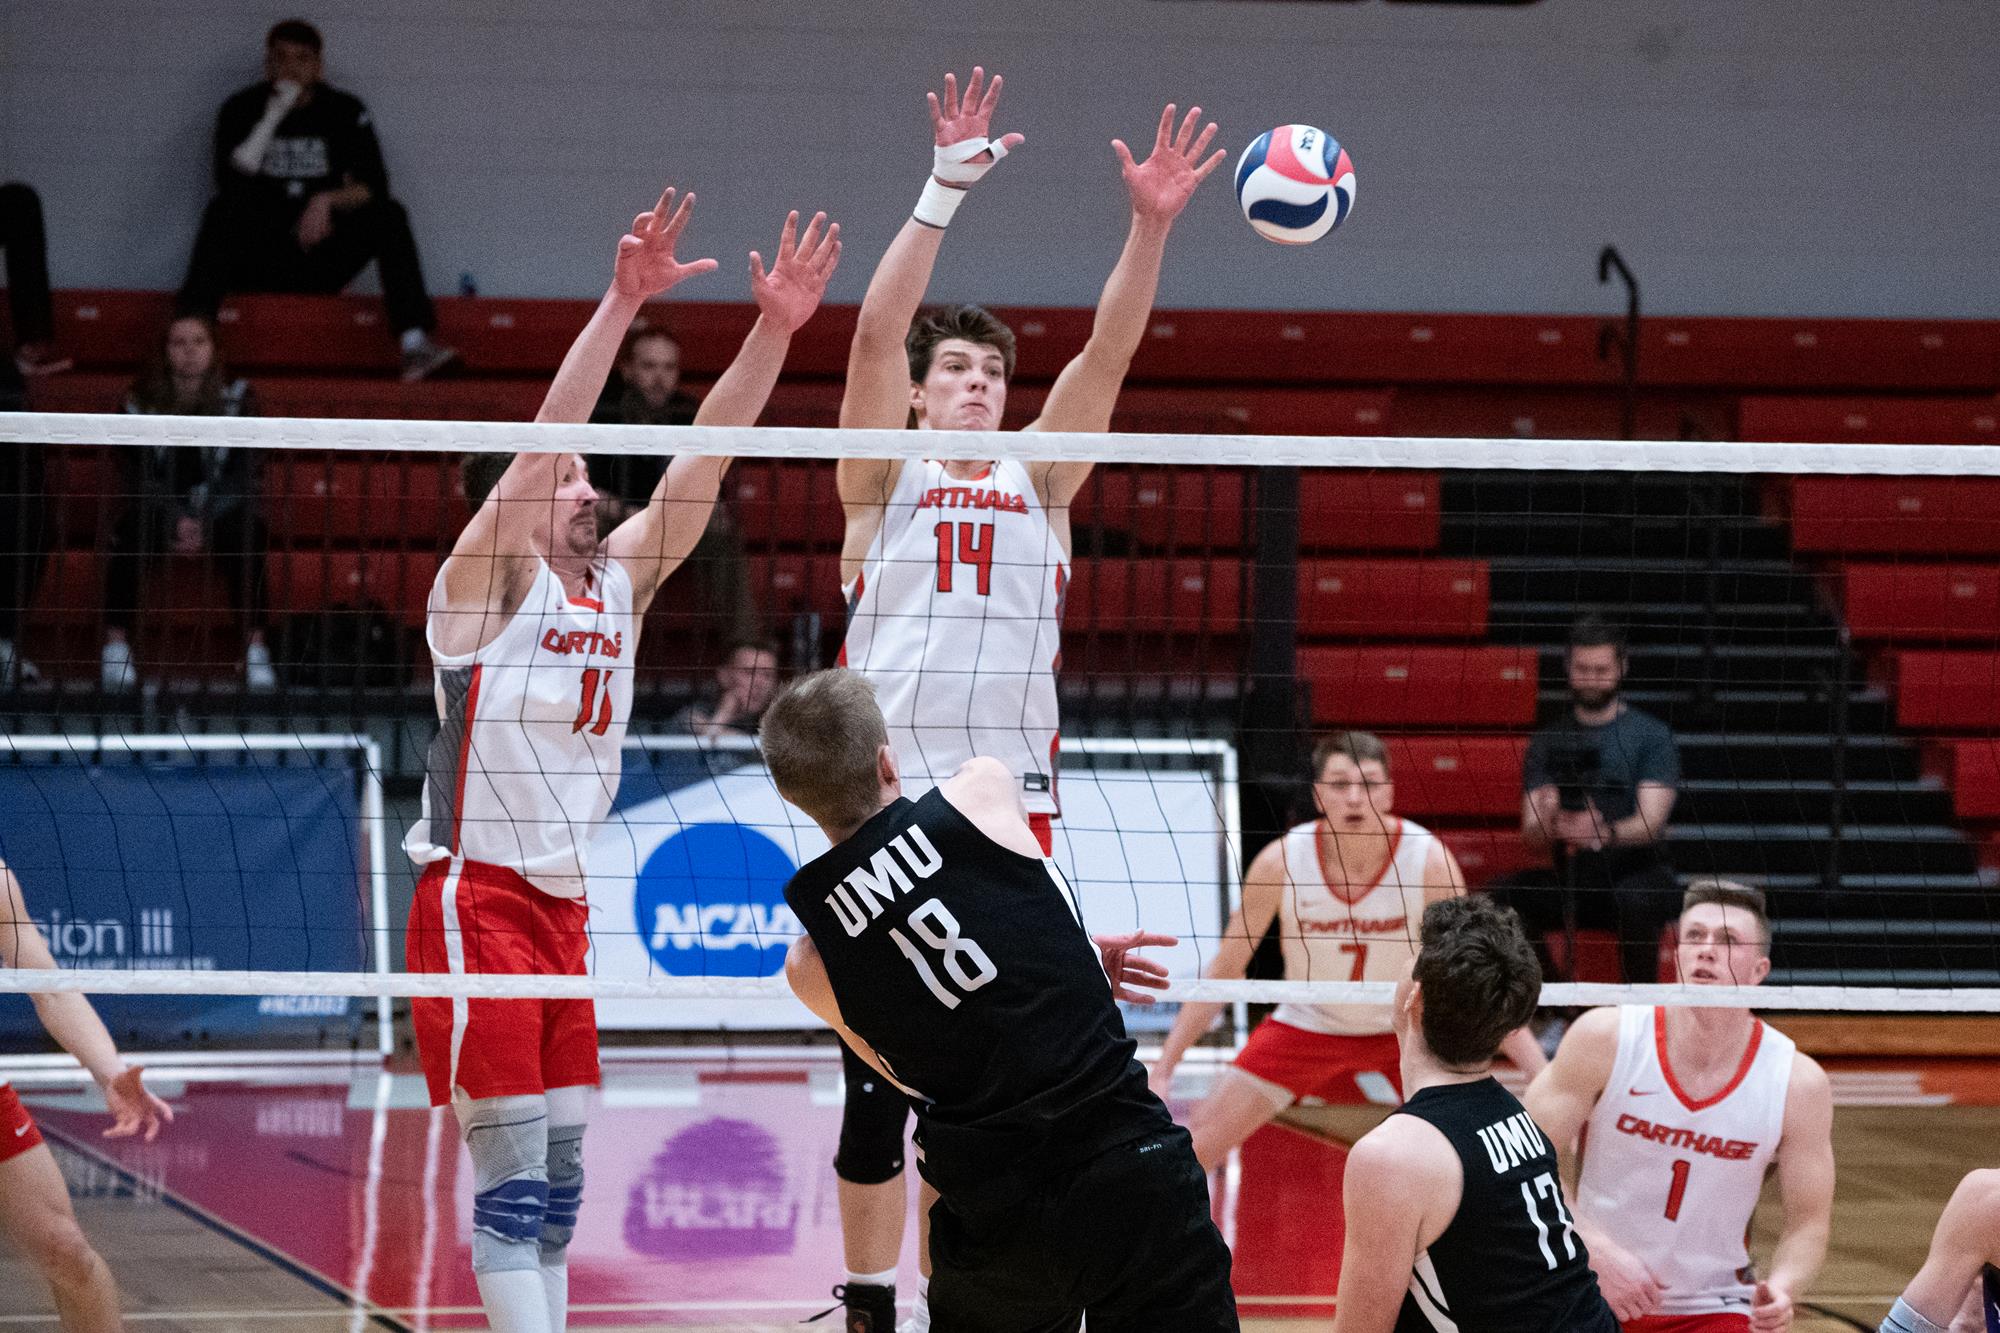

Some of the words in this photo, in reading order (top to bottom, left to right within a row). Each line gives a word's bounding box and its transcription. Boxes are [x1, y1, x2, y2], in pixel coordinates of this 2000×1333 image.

[933, 521, 995, 596] 14
[572, 668, 613, 736] 11
[824, 823, 944, 938] UMU
[141, 908, 174, 955] III
[651, 903, 806, 950] NCAA
[888, 898, 999, 1011] 18
[1339, 943, 1368, 982] 7
[1476, 1111, 1546, 1174] UMU
[1616, 1113, 1759, 1160] CARTHAGE
[1520, 1172, 1577, 1270] 17
[1664, 1158, 1691, 1222] 1
